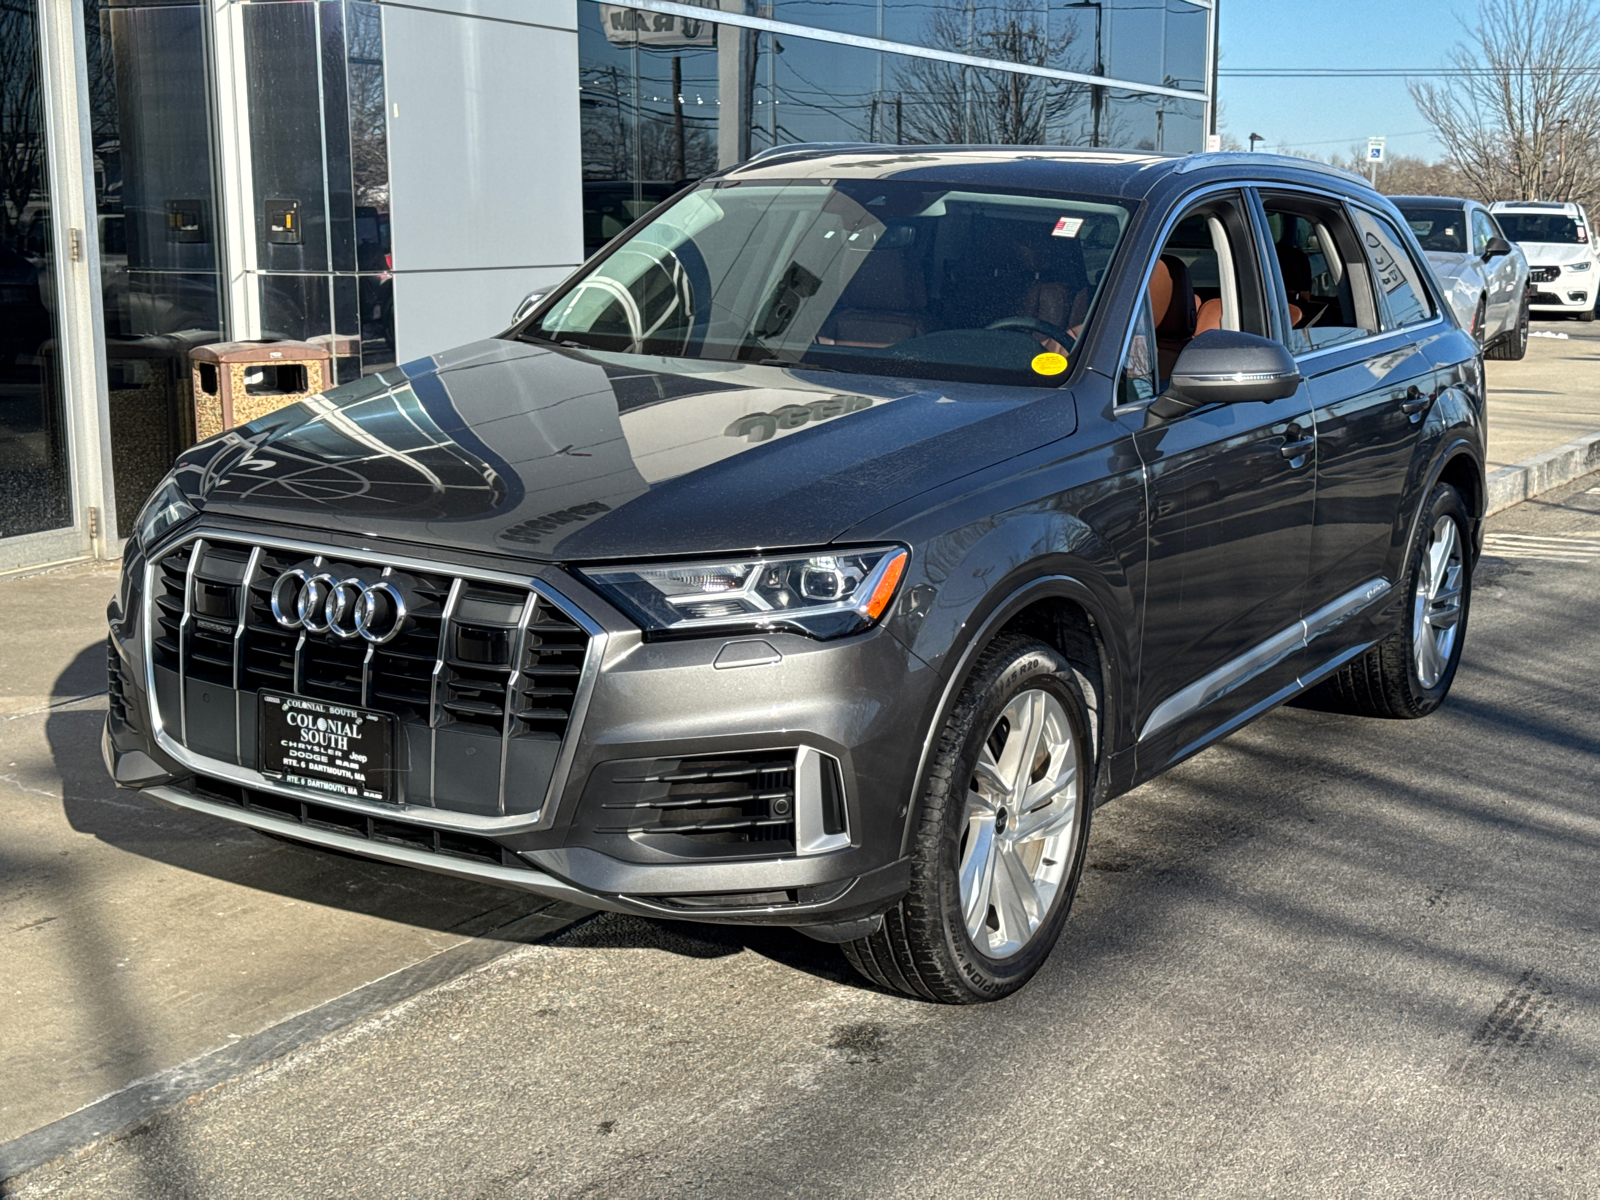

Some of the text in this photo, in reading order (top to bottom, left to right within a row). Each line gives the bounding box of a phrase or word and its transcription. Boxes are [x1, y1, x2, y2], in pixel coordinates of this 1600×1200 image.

[1020, 659, 1039, 676] R20
[286, 699, 326, 713] COLONIAL
[329, 707, 358, 718] SOUTH
[286, 711, 362, 739] COLONIAL
[300, 728, 348, 750] SOUTH
[280, 740, 342, 757] CHRYSLER
[289, 749, 328, 763] DODGE
[349, 751, 368, 763] Jeep
[354, 772, 366, 781] MA
[348, 786, 358, 795] MA
